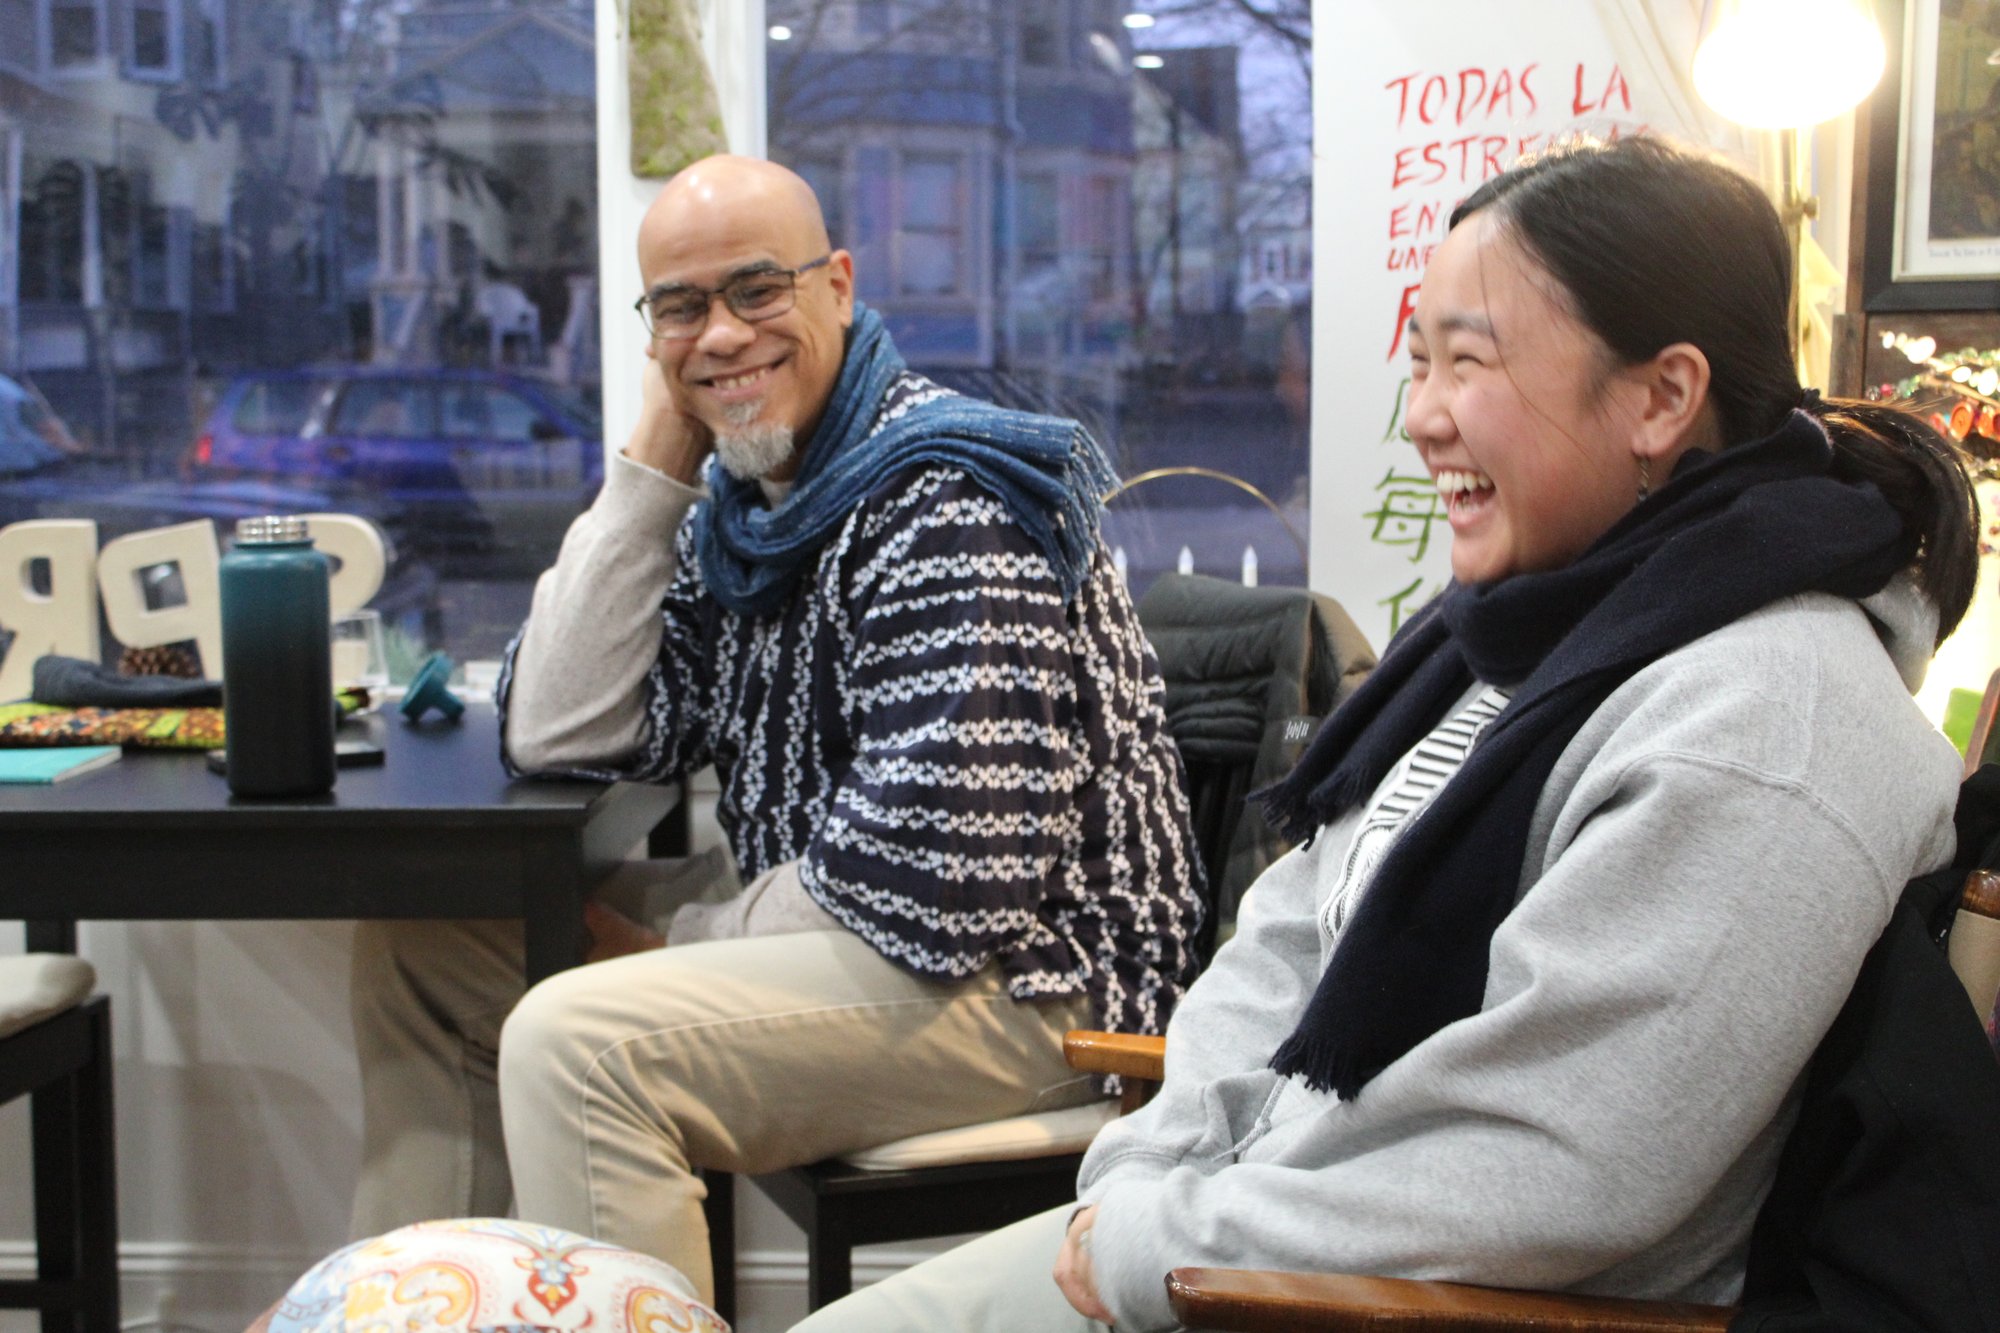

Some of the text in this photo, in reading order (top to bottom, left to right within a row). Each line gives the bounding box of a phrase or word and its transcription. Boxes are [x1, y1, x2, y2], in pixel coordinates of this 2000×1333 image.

[1385, 62, 1634, 132] TODAS LA
[1389, 199, 1441, 240] EN
